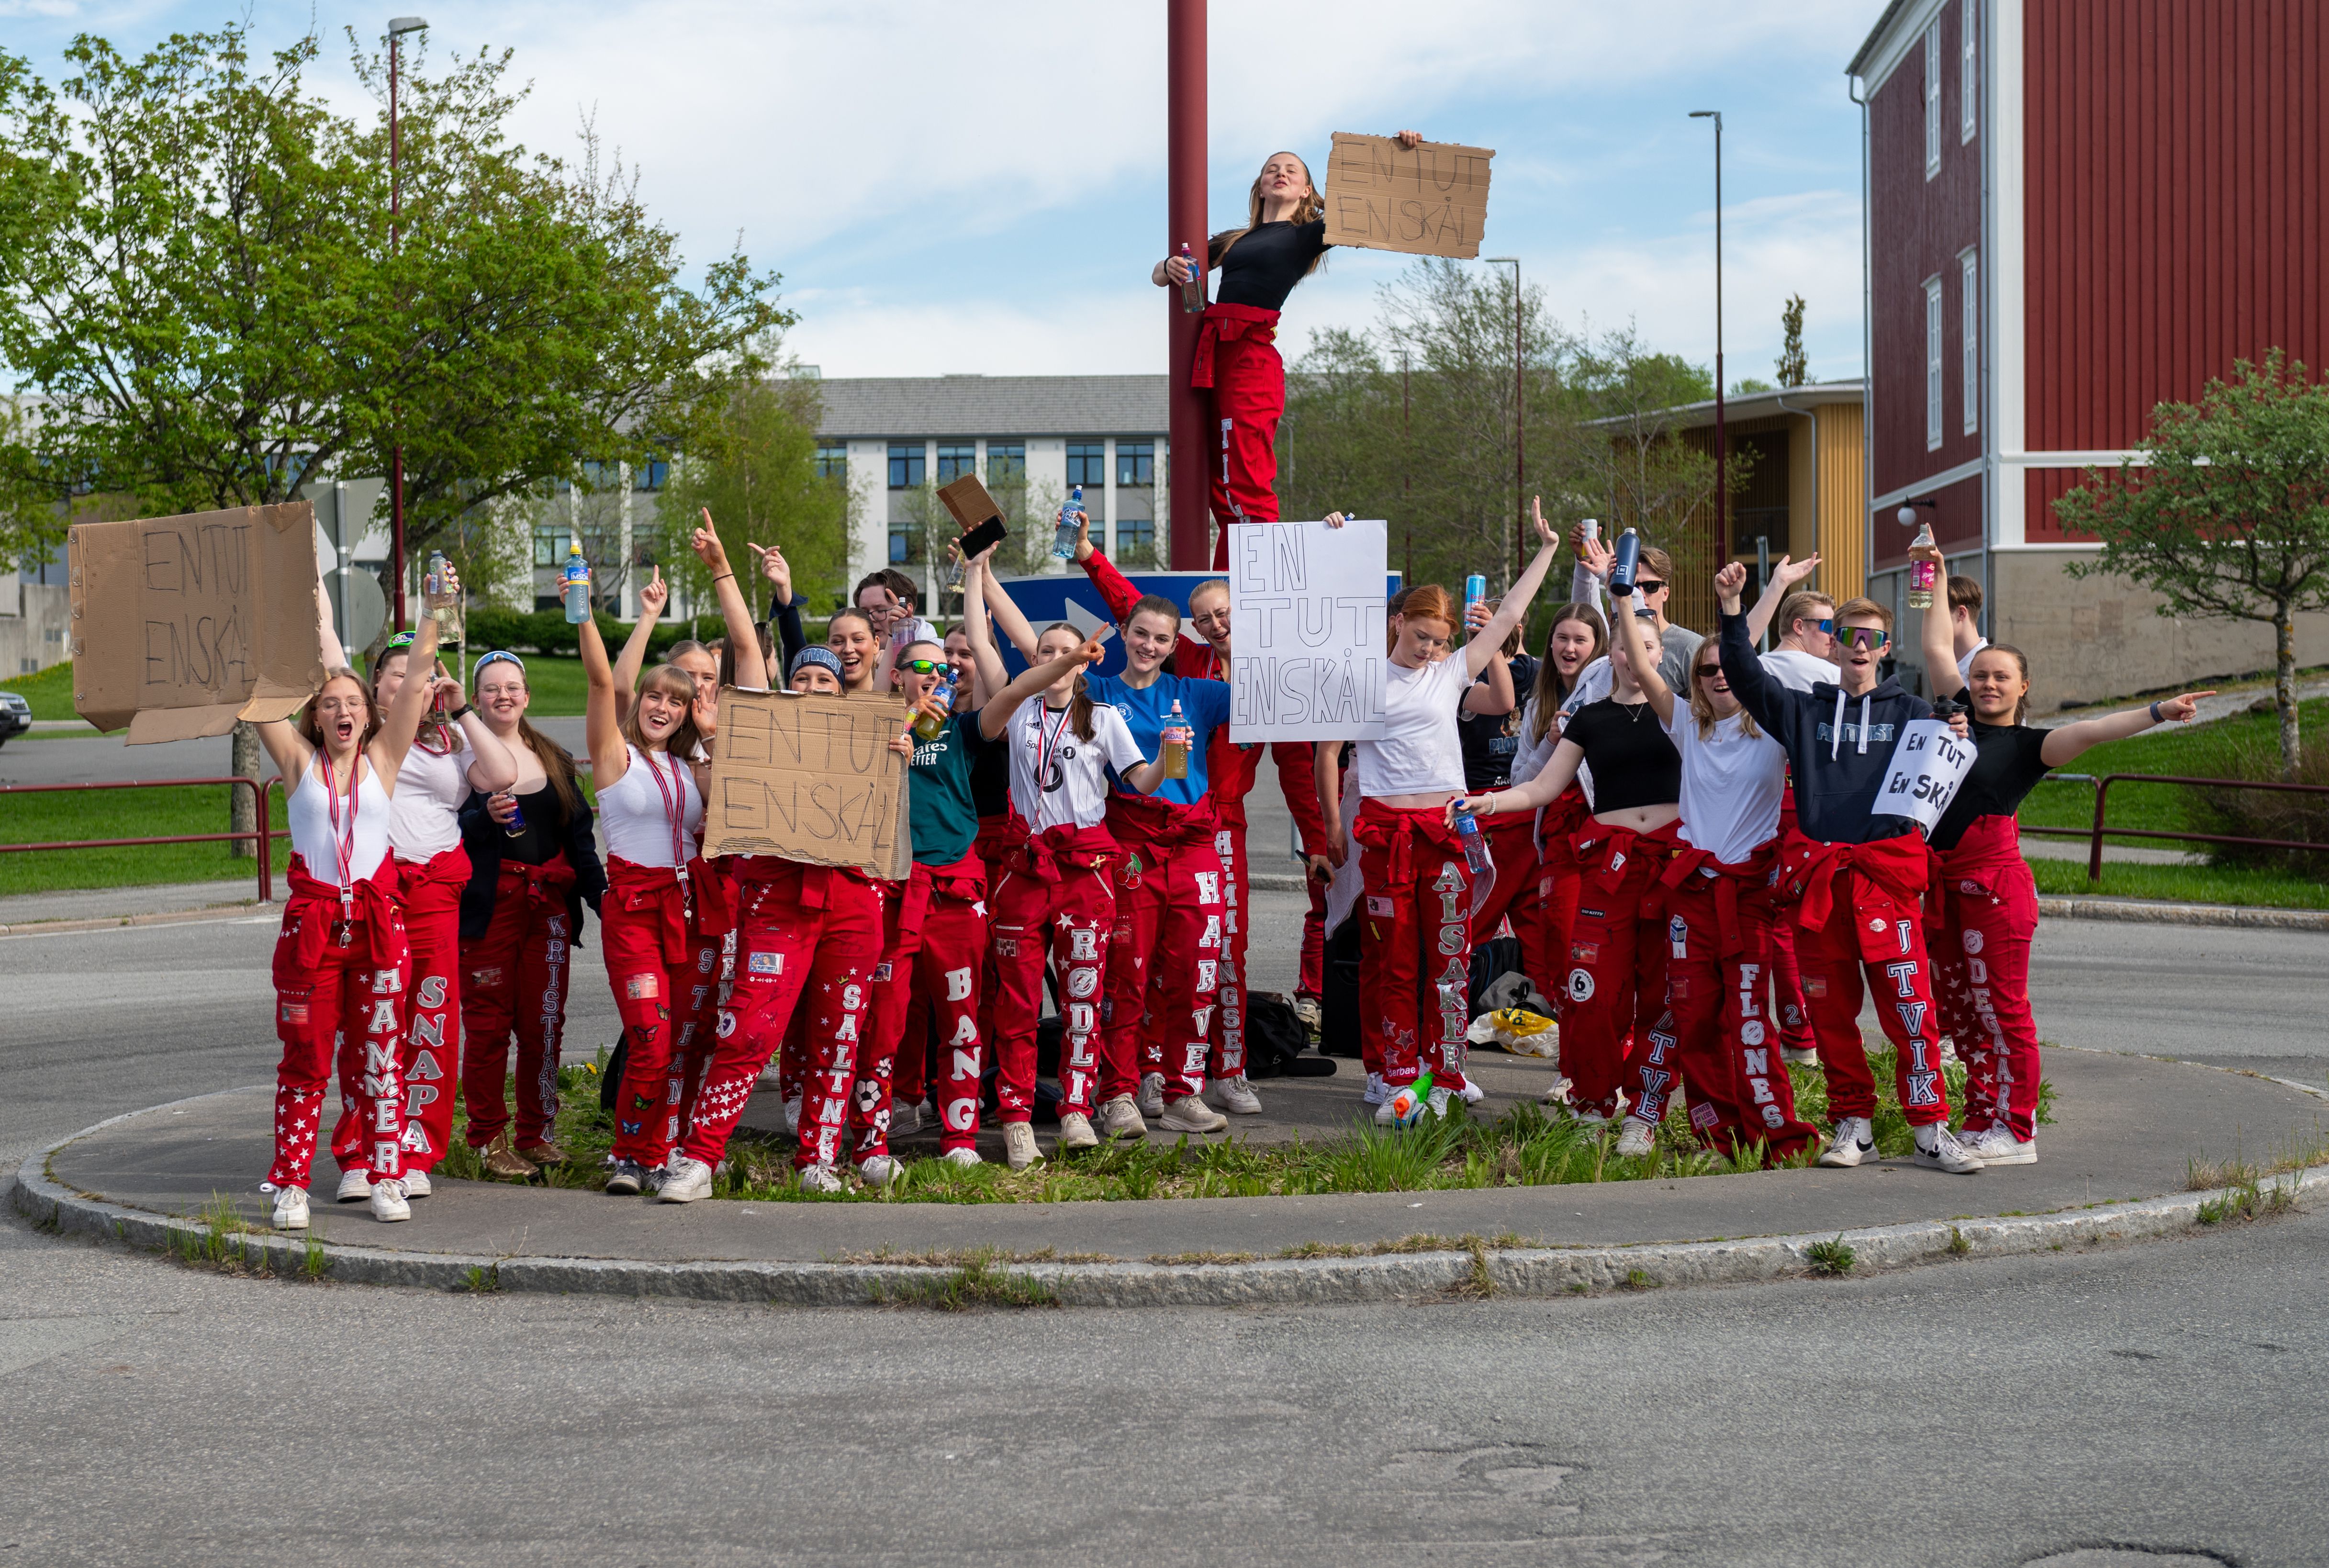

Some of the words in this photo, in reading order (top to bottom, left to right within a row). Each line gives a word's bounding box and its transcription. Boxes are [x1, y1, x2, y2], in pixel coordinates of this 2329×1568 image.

[1238, 524, 1307, 593] EN
[1241, 597, 1386, 648] TUT
[1888, 771, 1911, 794] EN
[1906, 732, 1927, 751] EN
[1937, 735, 1966, 770] TUT
[1067, 929, 1098, 1105] RØDLI
[1432, 861, 1467, 1074] ALSAKER
[1575, 975, 1586, 991] 6
[362, 970, 403, 1175] HAMMER
[816, 984, 862, 1167] SALTNES
[945, 966, 982, 1131] BANG
[1386, 1066, 1416, 1077] Barbae
[1739, 963, 1784, 1129] FLØNES
